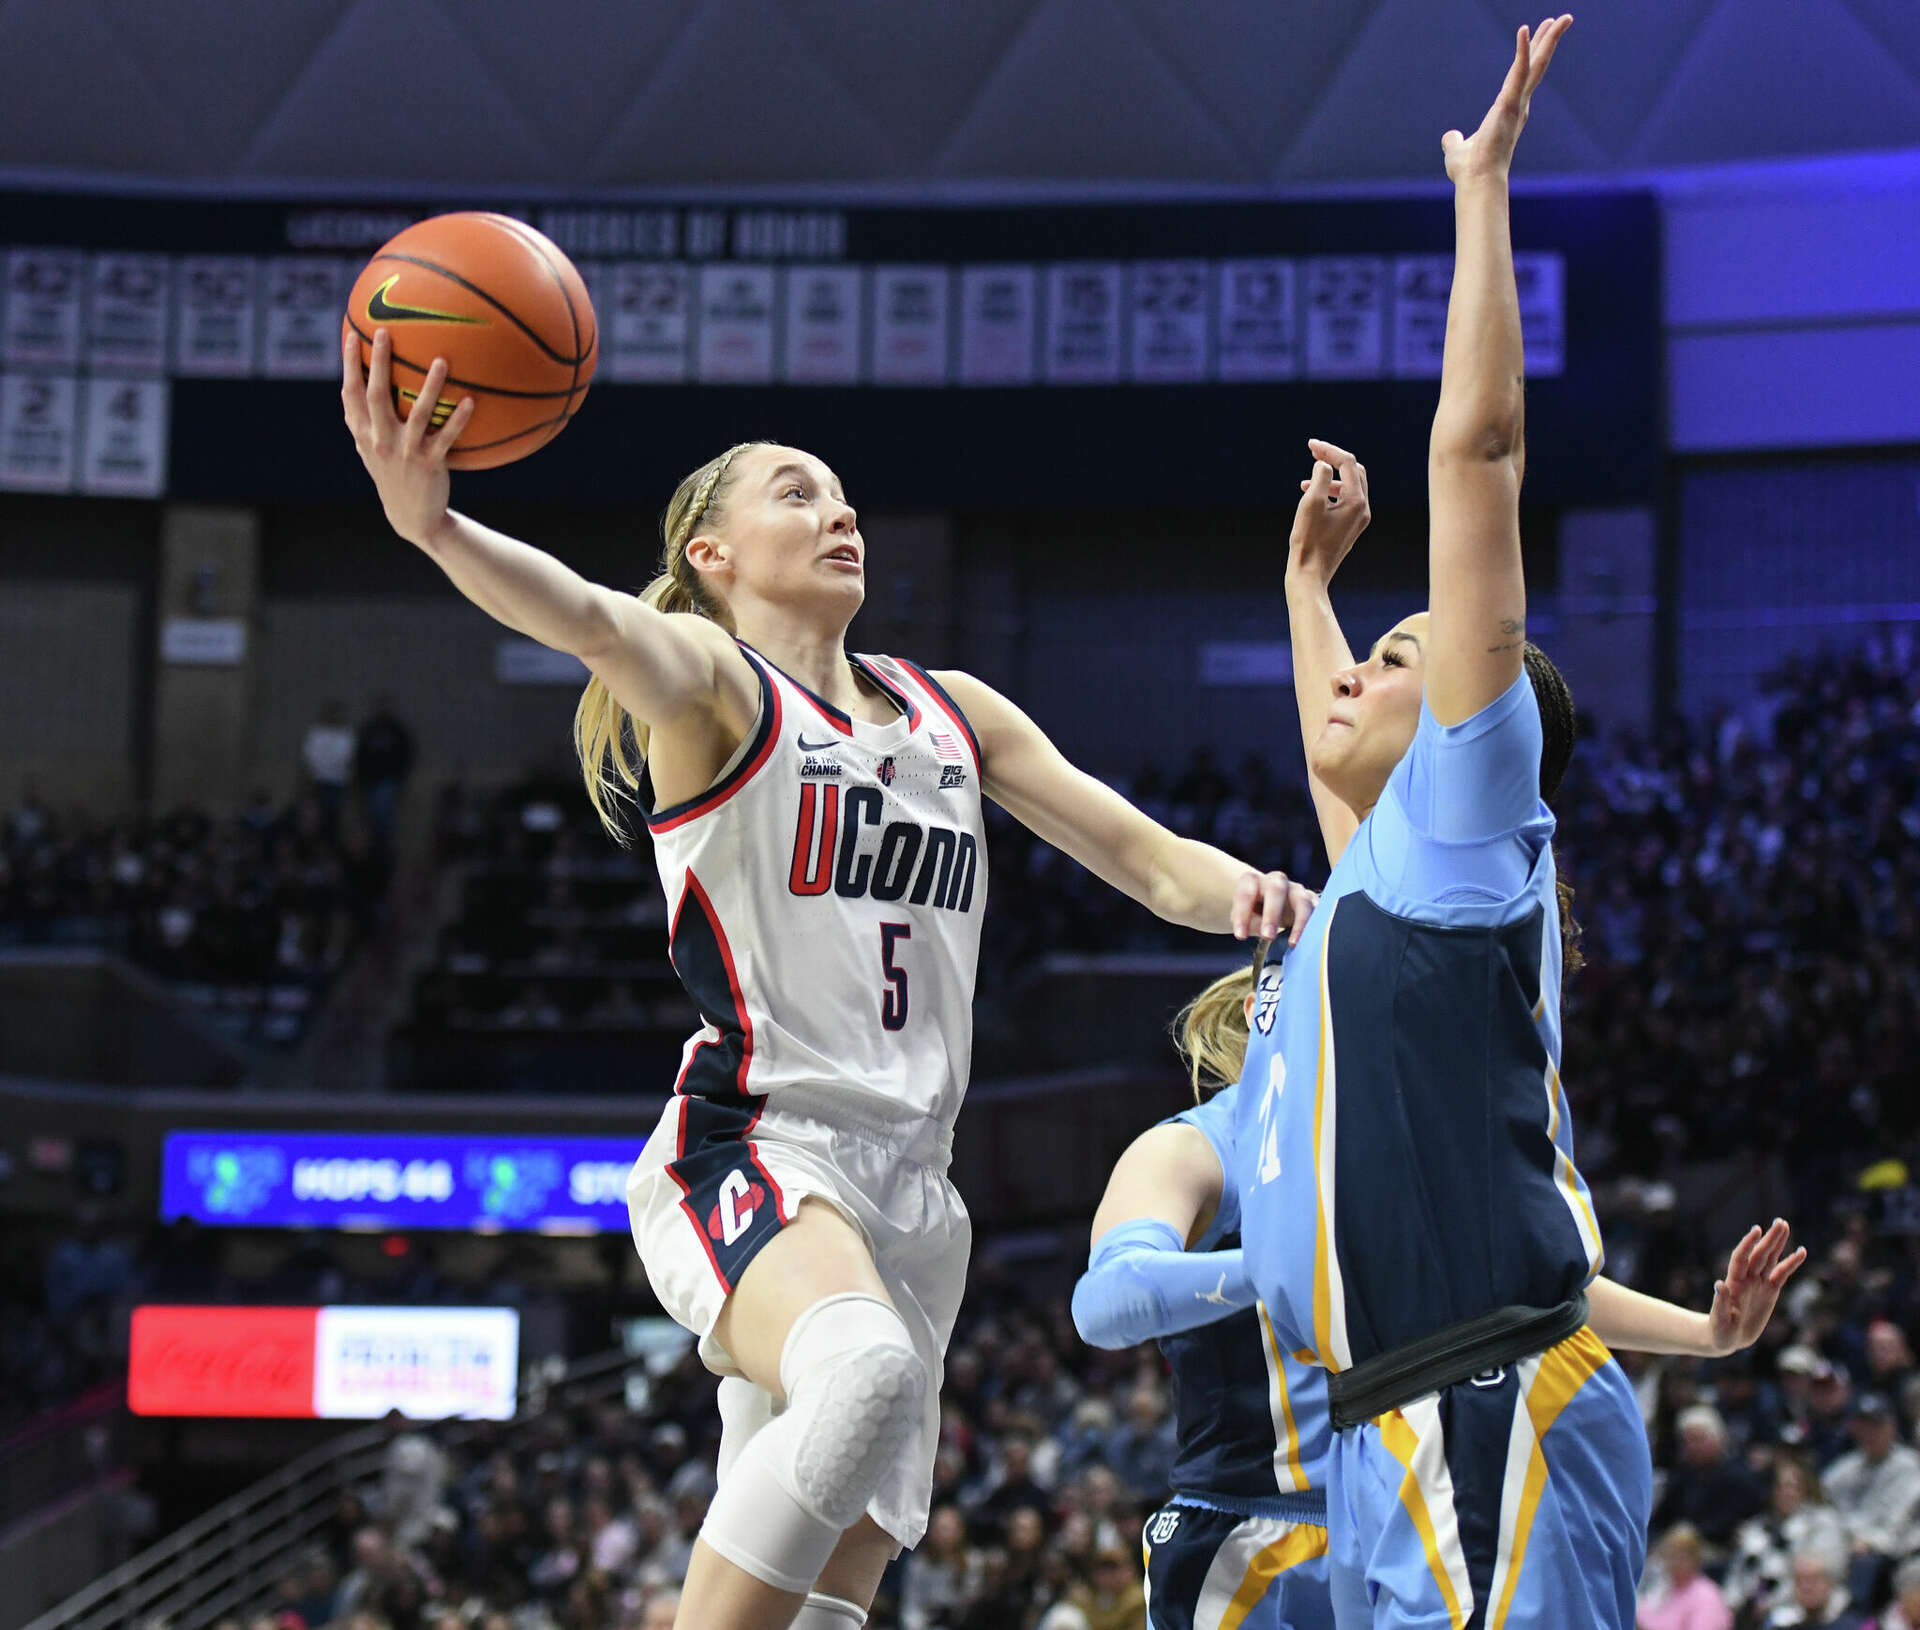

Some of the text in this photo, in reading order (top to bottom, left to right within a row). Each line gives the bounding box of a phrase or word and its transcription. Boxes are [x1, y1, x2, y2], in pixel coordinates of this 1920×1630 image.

[805, 755, 819, 765] BE
[801, 765, 842, 777] CHANGE
[942, 765, 964, 775] BIG
[940, 775, 967, 785] EAST
[879, 921, 912, 1032] 5
